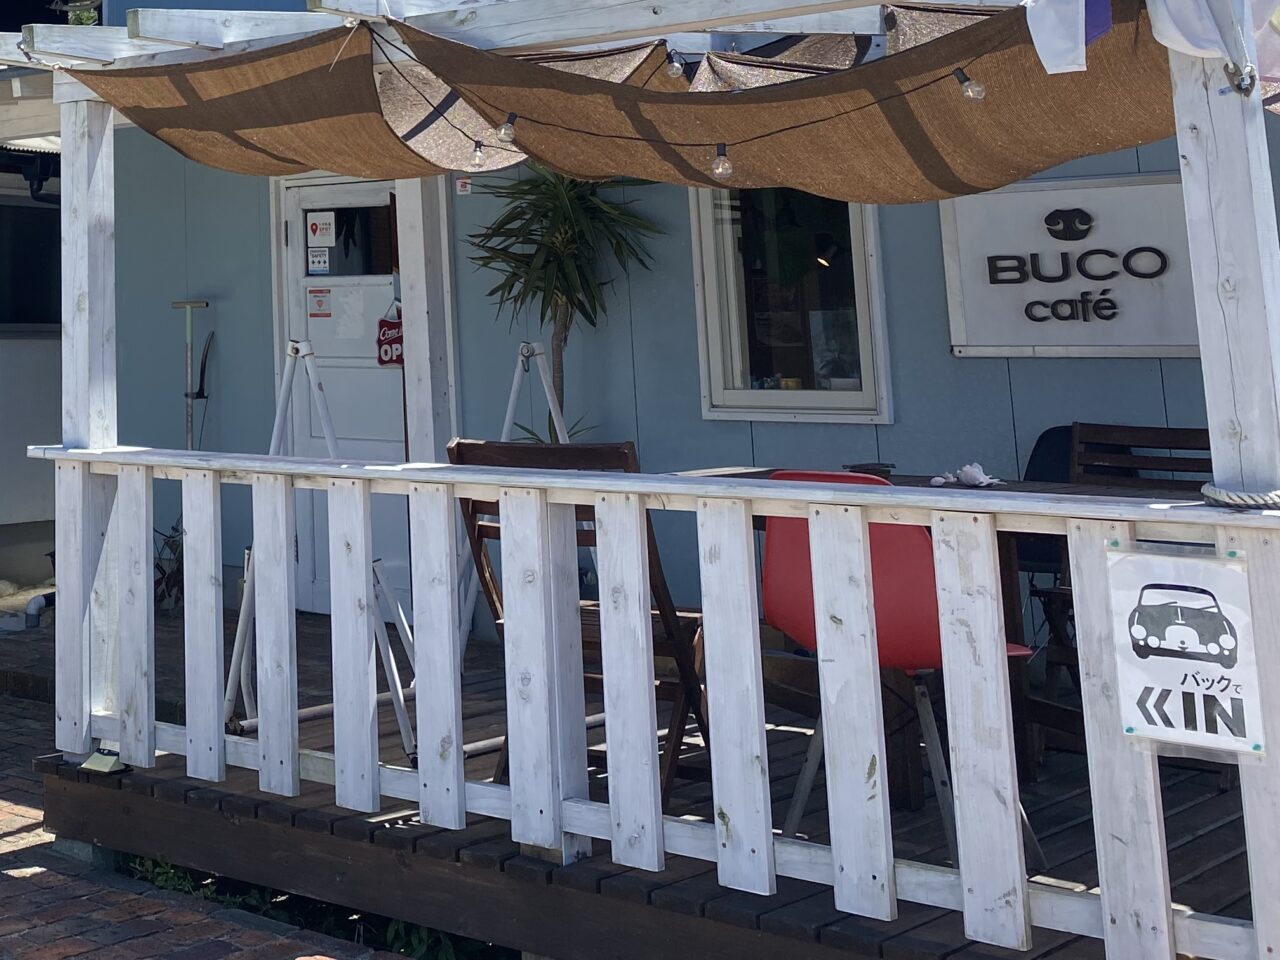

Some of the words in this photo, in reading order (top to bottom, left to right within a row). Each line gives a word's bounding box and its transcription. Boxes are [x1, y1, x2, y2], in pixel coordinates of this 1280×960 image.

[986, 246, 1168, 284] BUCO
[1024, 289, 1118, 322] café
[380, 344, 402, 361] OP
[1181, 691, 1247, 738] IN
